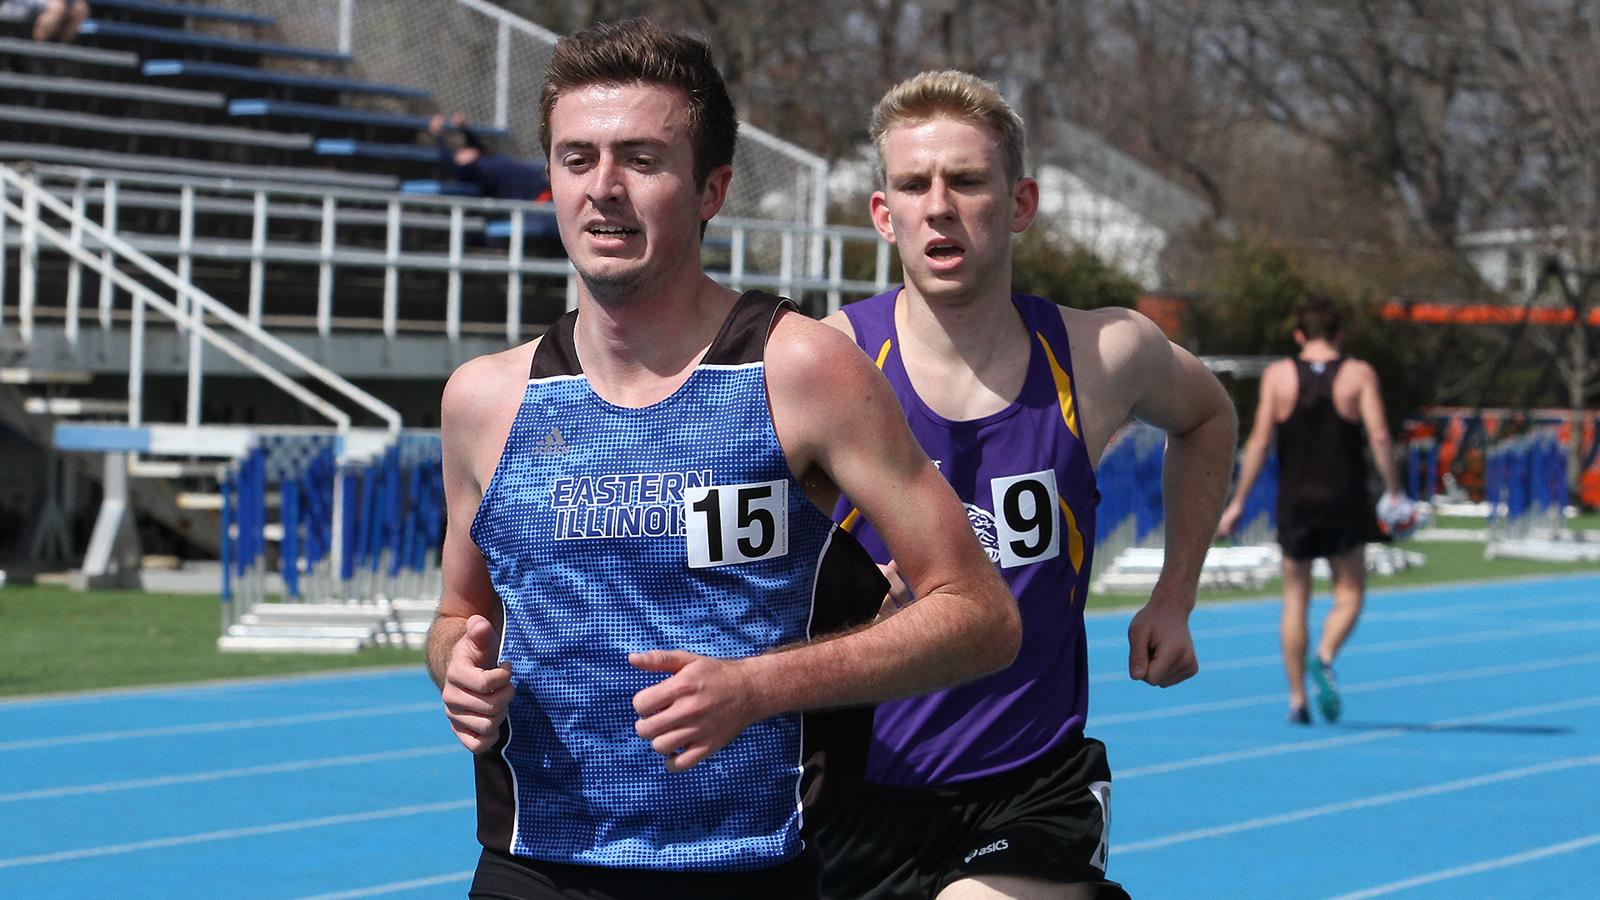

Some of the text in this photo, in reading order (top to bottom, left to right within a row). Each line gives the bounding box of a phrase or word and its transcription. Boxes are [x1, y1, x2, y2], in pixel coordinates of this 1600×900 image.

[550, 469, 712, 508] EASTERN
[554, 503, 687, 540] ILLINOI
[693, 485, 775, 563] 15
[1003, 479, 1053, 559] 9
